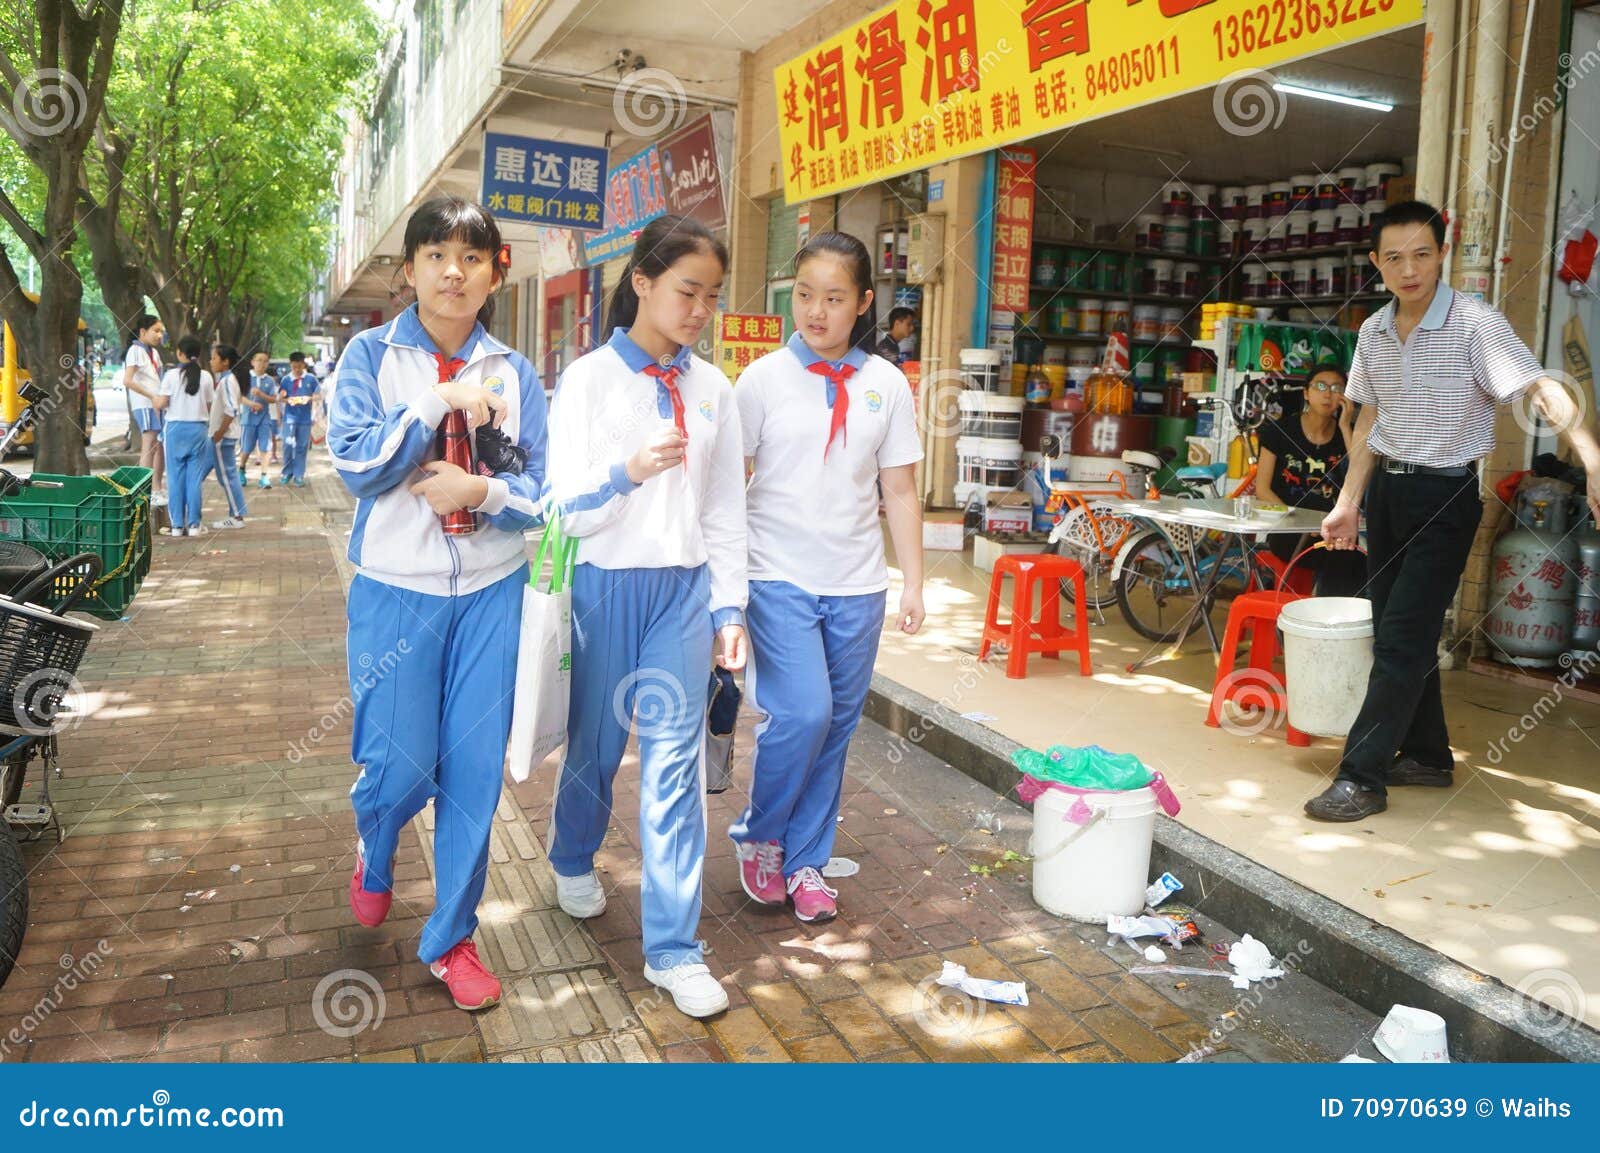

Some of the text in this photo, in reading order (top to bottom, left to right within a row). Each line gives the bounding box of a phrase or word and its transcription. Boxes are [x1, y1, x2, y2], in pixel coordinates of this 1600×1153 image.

[803, 0, 980, 150] 润滑油
[990, 87, 1021, 134] 黄油
[1085, 35, 1180, 101] 84805011
[784, 69, 805, 194] 建华
[494, 146, 600, 193] 惠达隆
[488, 192, 600, 222] 水暖阀门批发
[724, 316, 780, 339] 蓄电池
